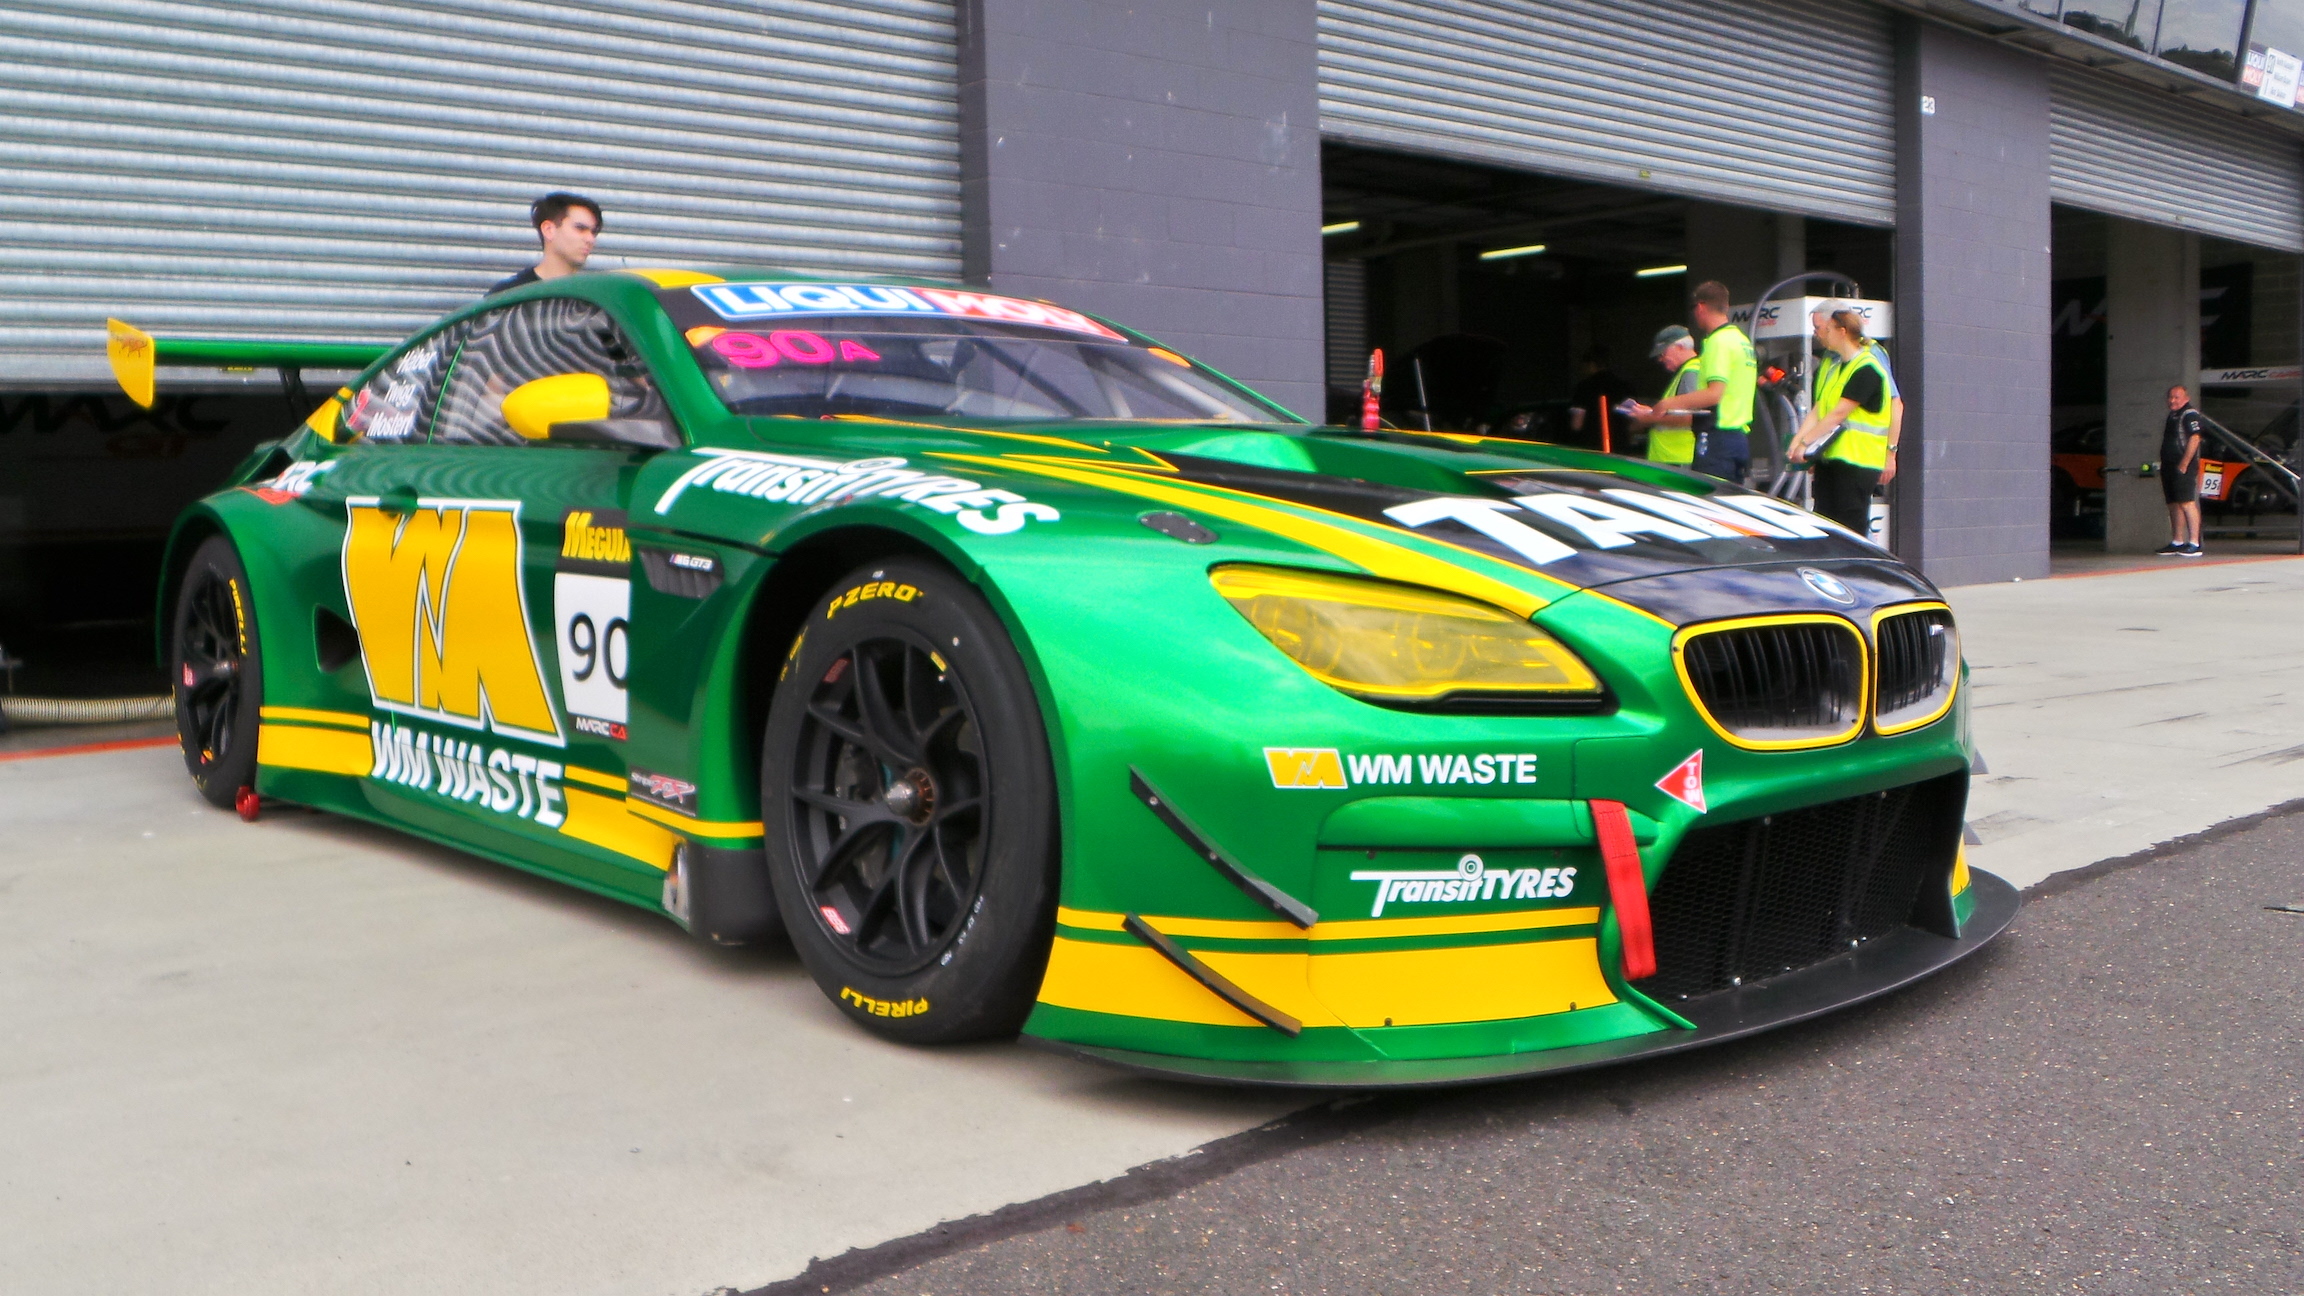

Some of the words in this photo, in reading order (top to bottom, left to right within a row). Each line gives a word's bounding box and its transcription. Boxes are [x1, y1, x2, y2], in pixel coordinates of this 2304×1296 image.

[710, 285, 935, 313] LIQUI
[920, 290, 1103, 333] MOLY
[2221, 369, 2268, 380] MARC
[384, 379, 417, 408] Twigg
[366, 410, 415, 437] Mostert
[568, 611, 629, 690] 90
[372, 721, 432, 790] WM
[432, 734, 566, 829] WASTE
[1347, 754, 1412, 784] WM
[1418, 754, 1537, 784] WASTE
[1683, 762, 1701, 803] TOW
[840, 986, 929, 1018] PIRELLI
